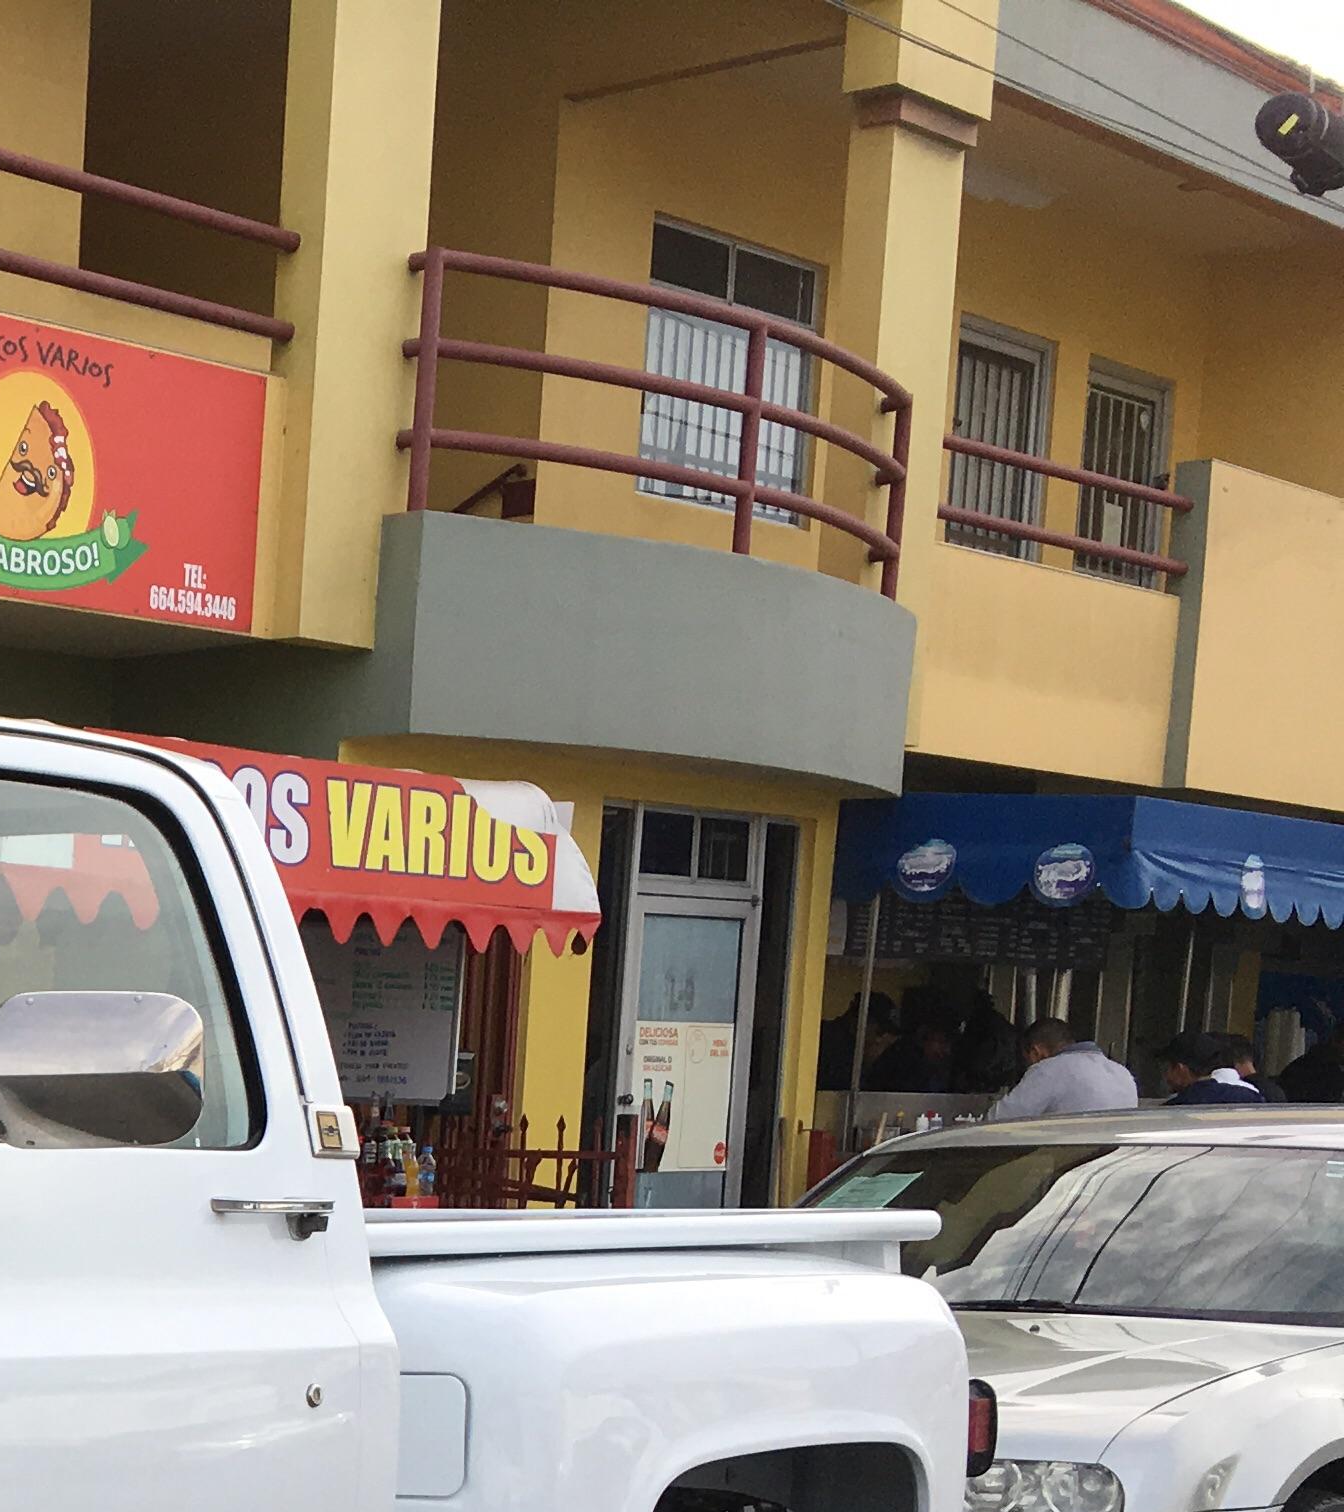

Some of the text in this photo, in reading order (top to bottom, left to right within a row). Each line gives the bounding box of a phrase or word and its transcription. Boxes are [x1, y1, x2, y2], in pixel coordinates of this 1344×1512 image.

[36, 341, 114, 388] VARIOS
[183, 563, 207, 590] TEL:
[149, 585, 237, 621] 664.594.3446
[229, 765, 550, 888] OS VARIOS
[639, 1027, 679, 1038] DELICIOSA
